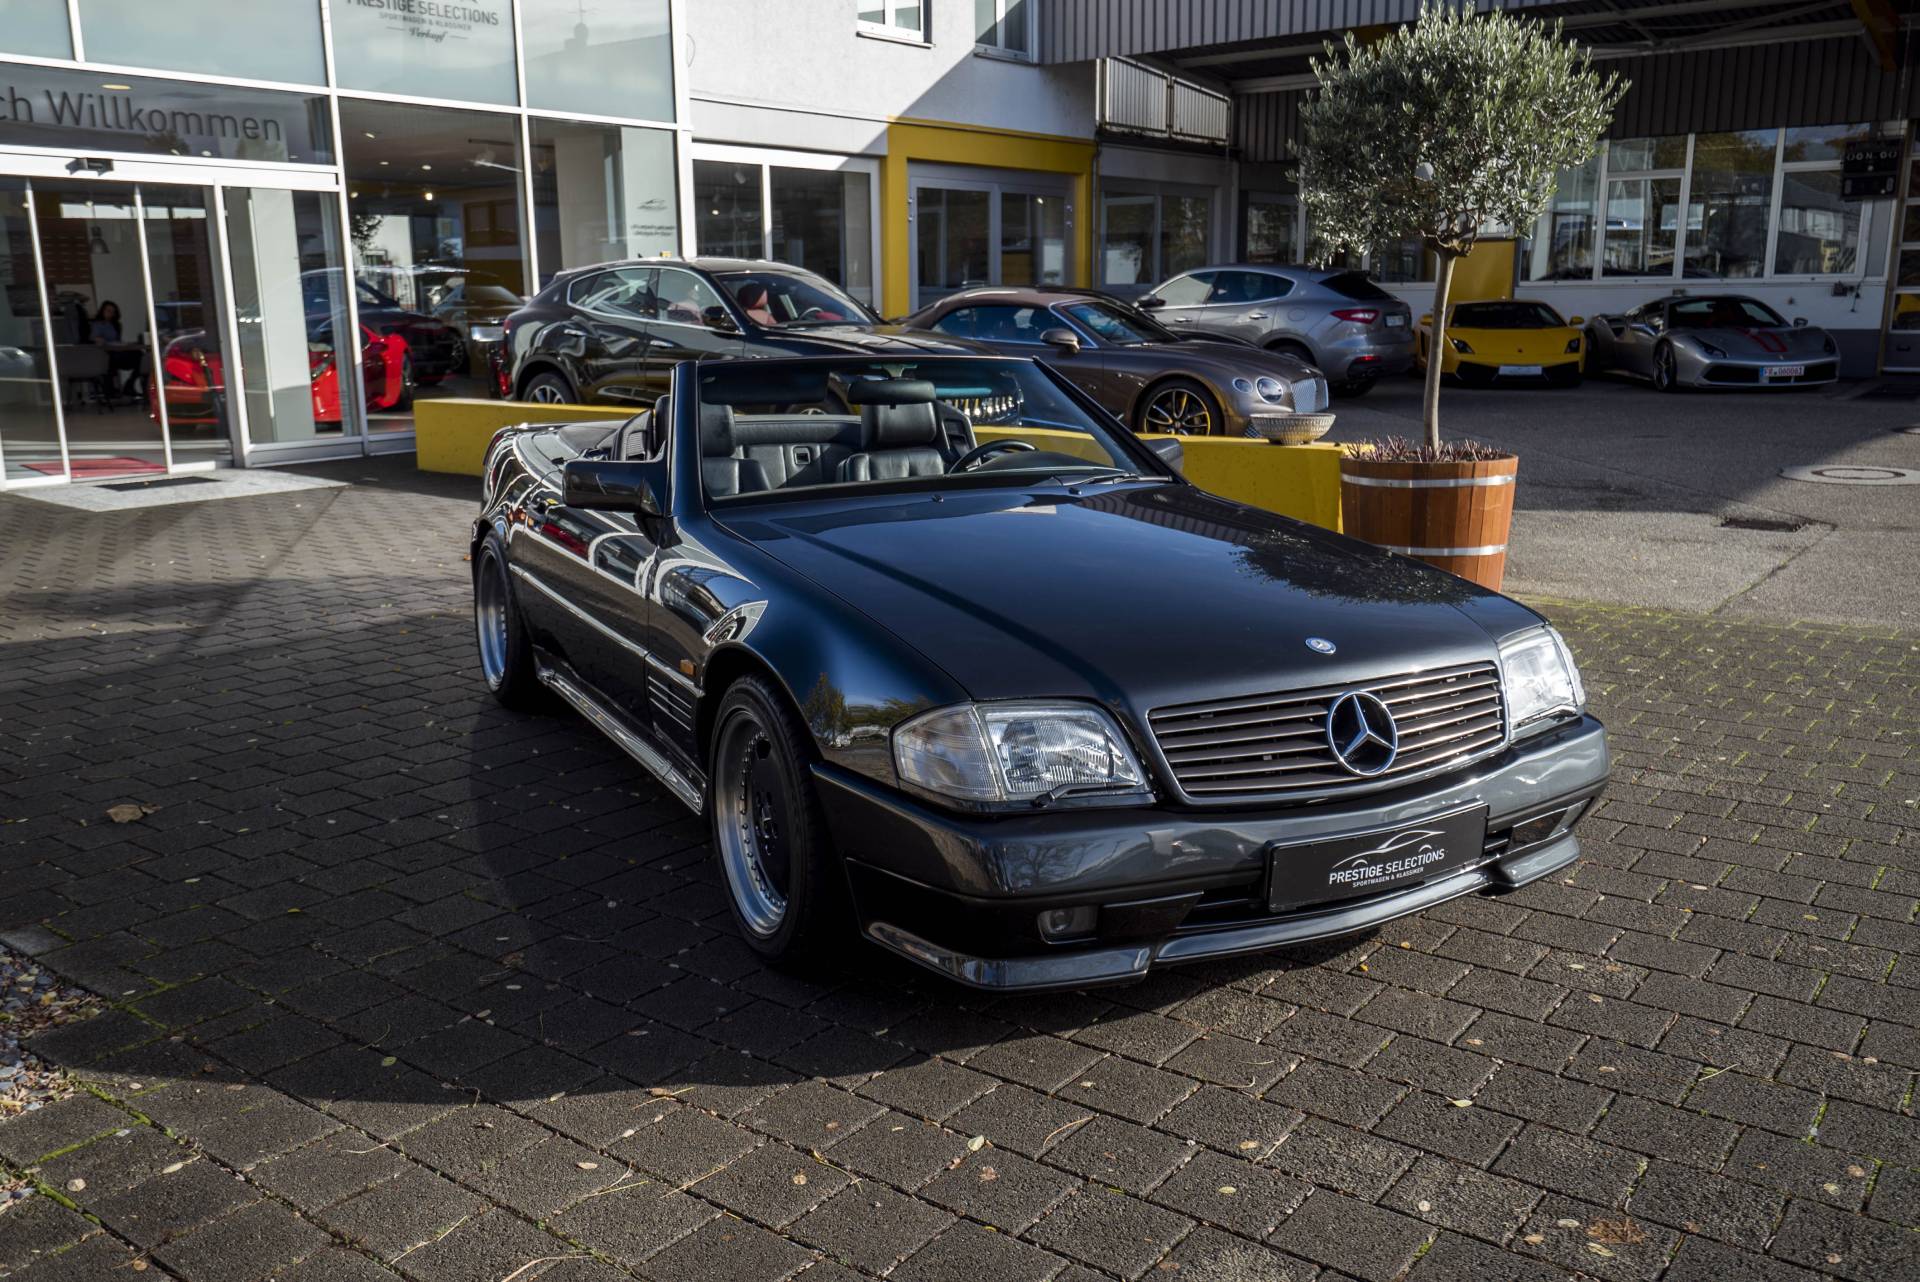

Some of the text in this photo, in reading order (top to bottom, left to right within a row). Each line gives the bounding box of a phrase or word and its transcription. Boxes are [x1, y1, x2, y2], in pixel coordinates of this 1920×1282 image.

[347, 0, 499, 26] ESTIGE SELECTIONS
[44, 89, 281, 142] Willkommen
[1328, 848, 1445, 885] PRESTIGE SELECTIONS
[1352, 875, 1390, 888] SPORTWAGEN
[1396, 867, 1424, 878] KLASSIKER
